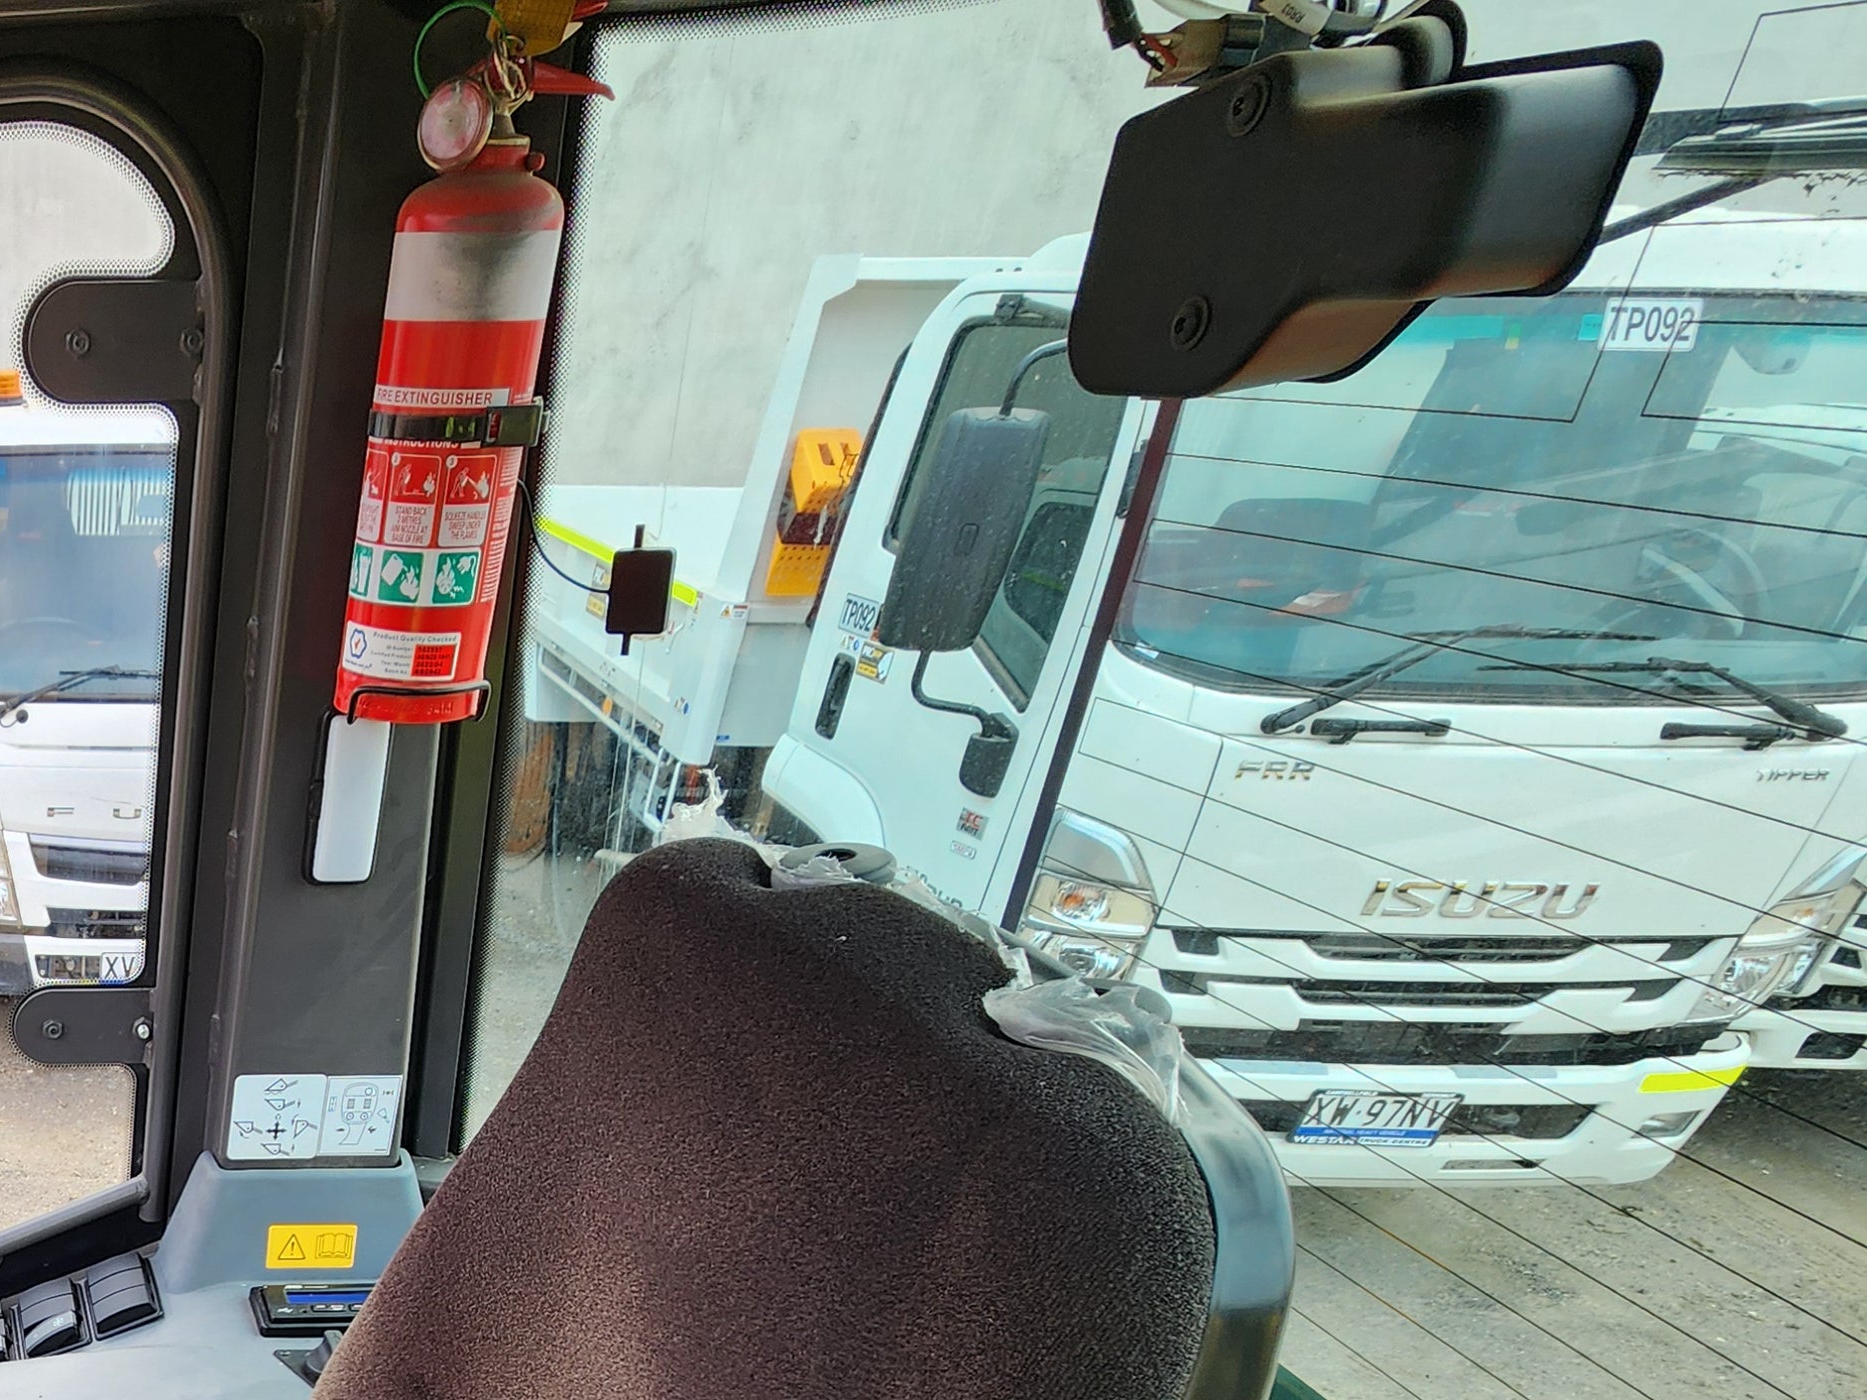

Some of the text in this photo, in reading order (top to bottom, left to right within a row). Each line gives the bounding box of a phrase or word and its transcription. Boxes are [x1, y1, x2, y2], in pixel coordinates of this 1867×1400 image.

[1610, 306, 1695, 342] TP092
[376, 387, 493, 405] FIRE EXTINGUISHER
[842, 600, 876, 632] TP092
[1235, 760, 1314, 779] FRR
[1360, 879, 1602, 919] ISUZU
[1293, 1135, 1357, 1145] WESTAR
